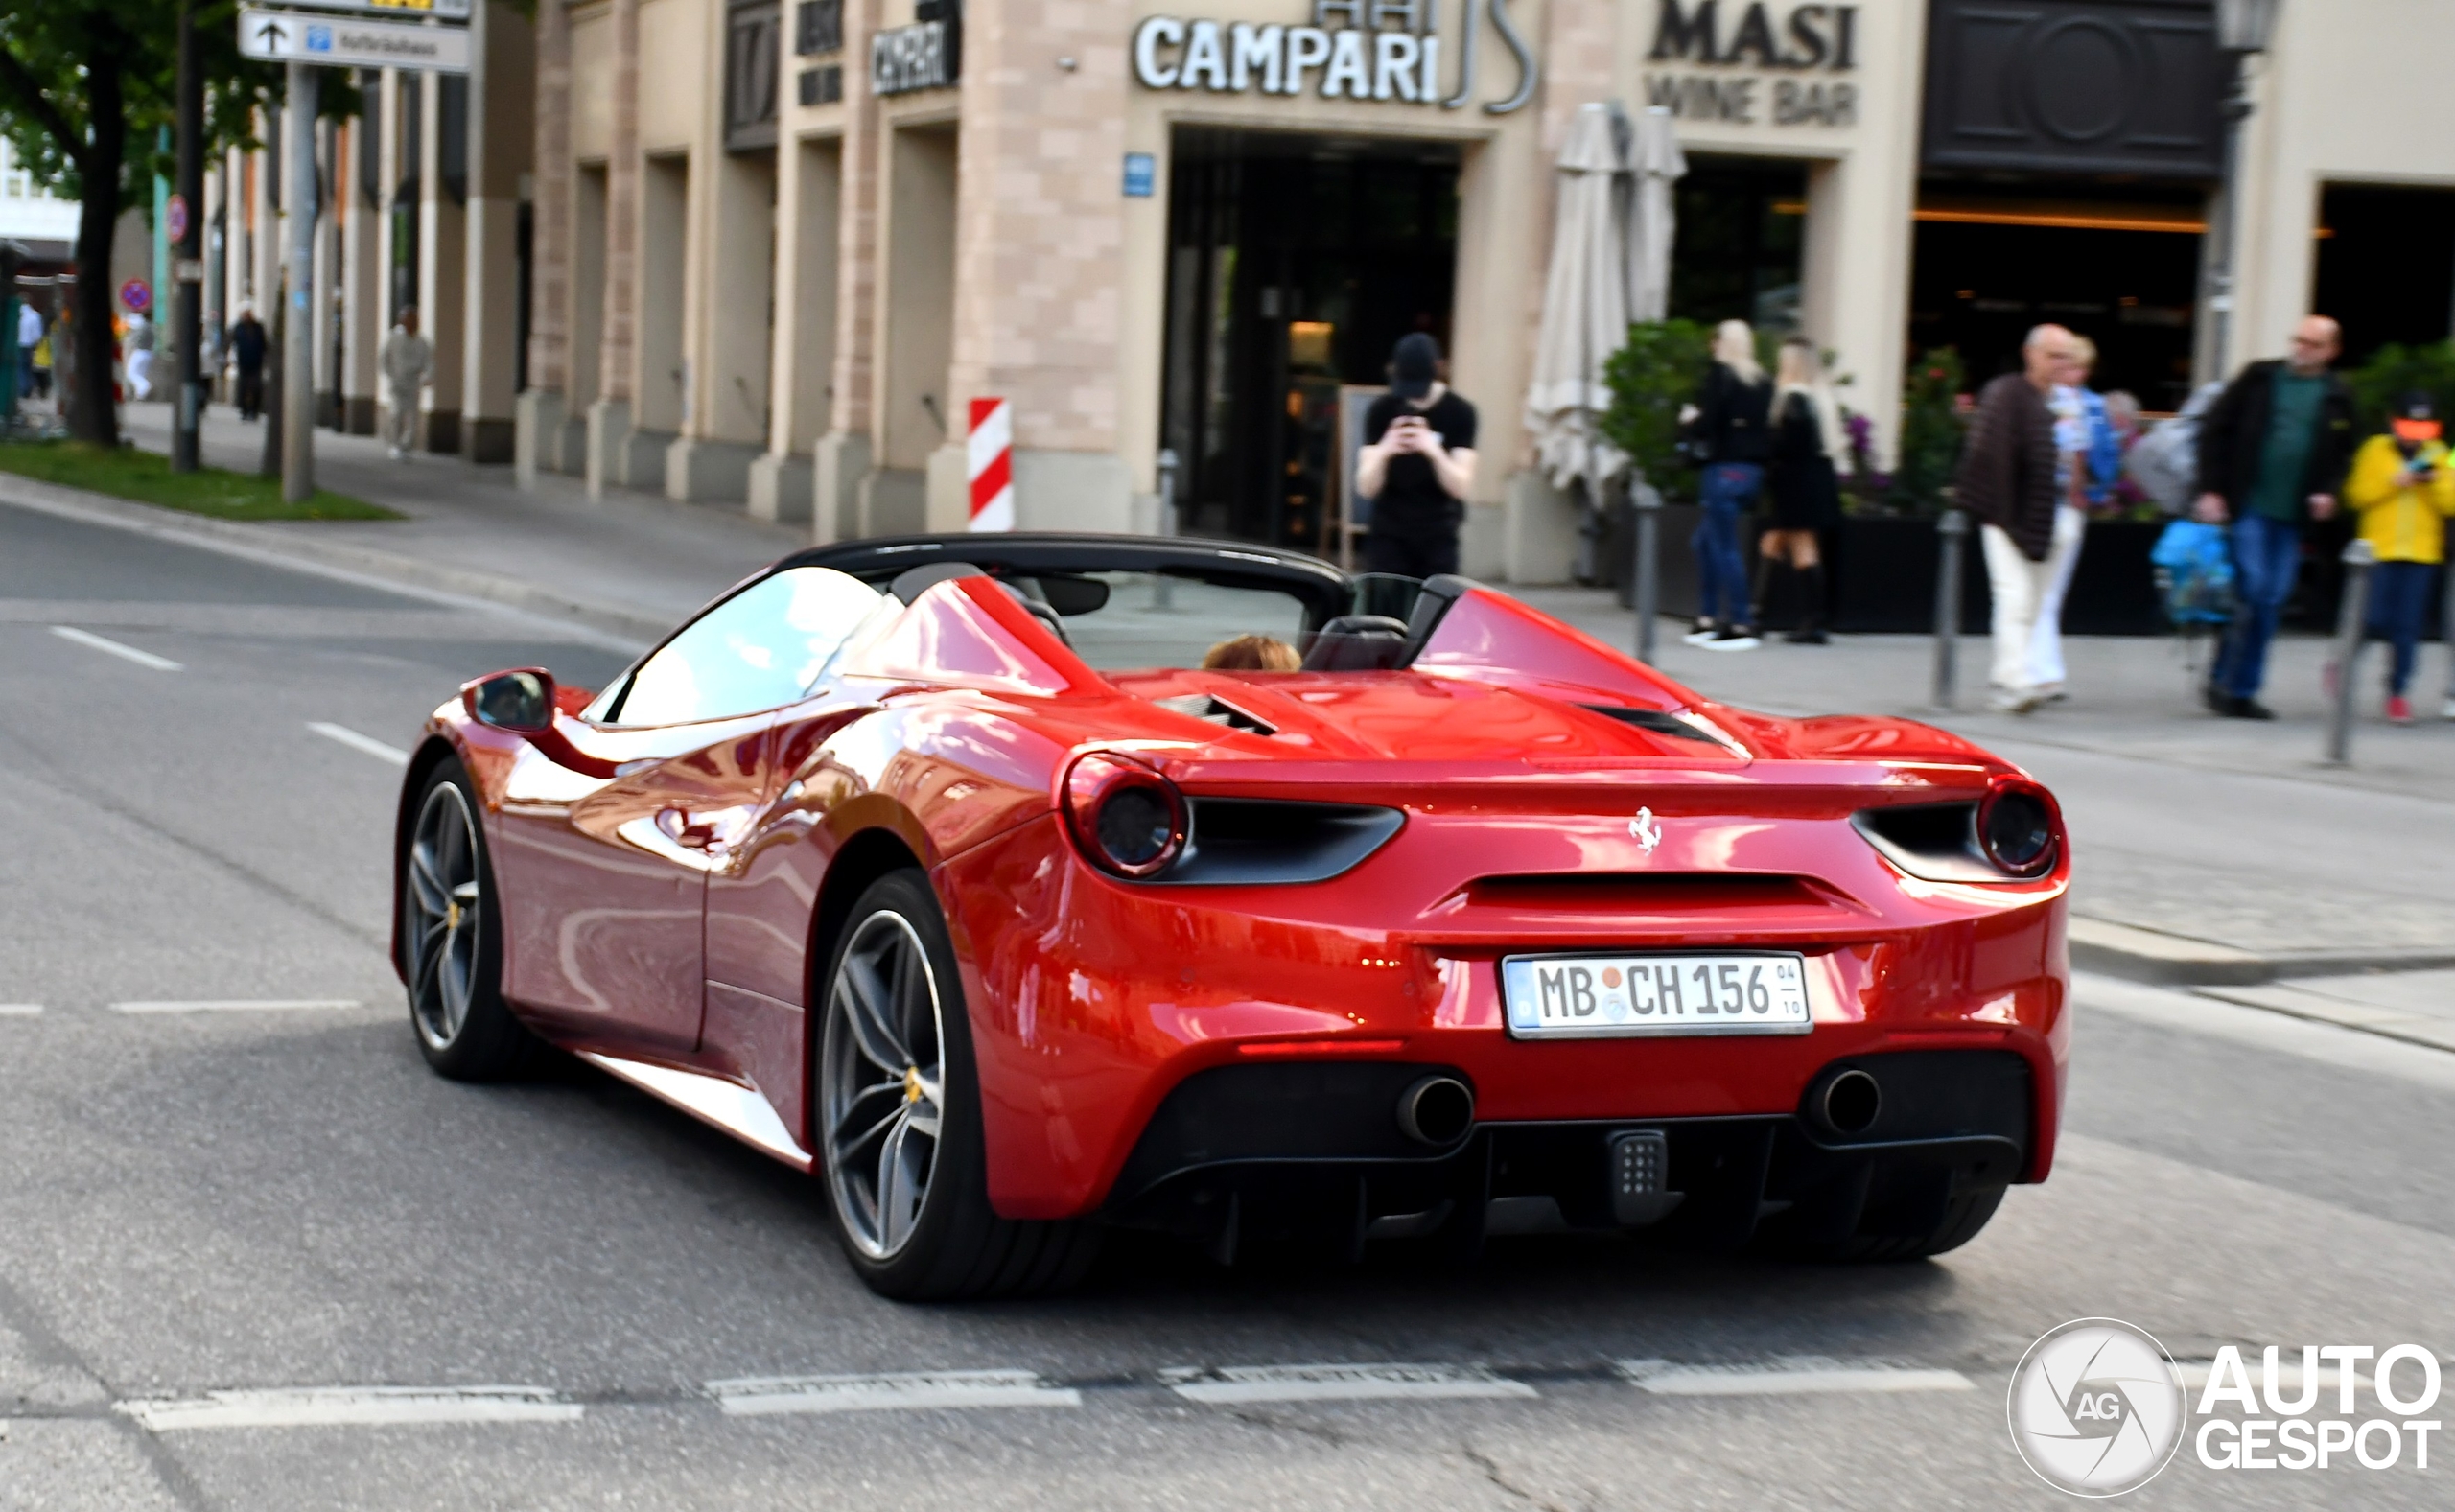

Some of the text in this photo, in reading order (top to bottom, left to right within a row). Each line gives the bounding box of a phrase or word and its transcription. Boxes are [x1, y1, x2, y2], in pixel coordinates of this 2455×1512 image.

[1134, 16, 1439, 103] CAMPARI
[1647, 0, 1858, 72] MASI
[1773, 79, 1859, 127] BAR
[1539, 966, 1596, 1017] MB
[1628, 965, 1683, 1015] CH
[1693, 965, 1769, 1014] 156
